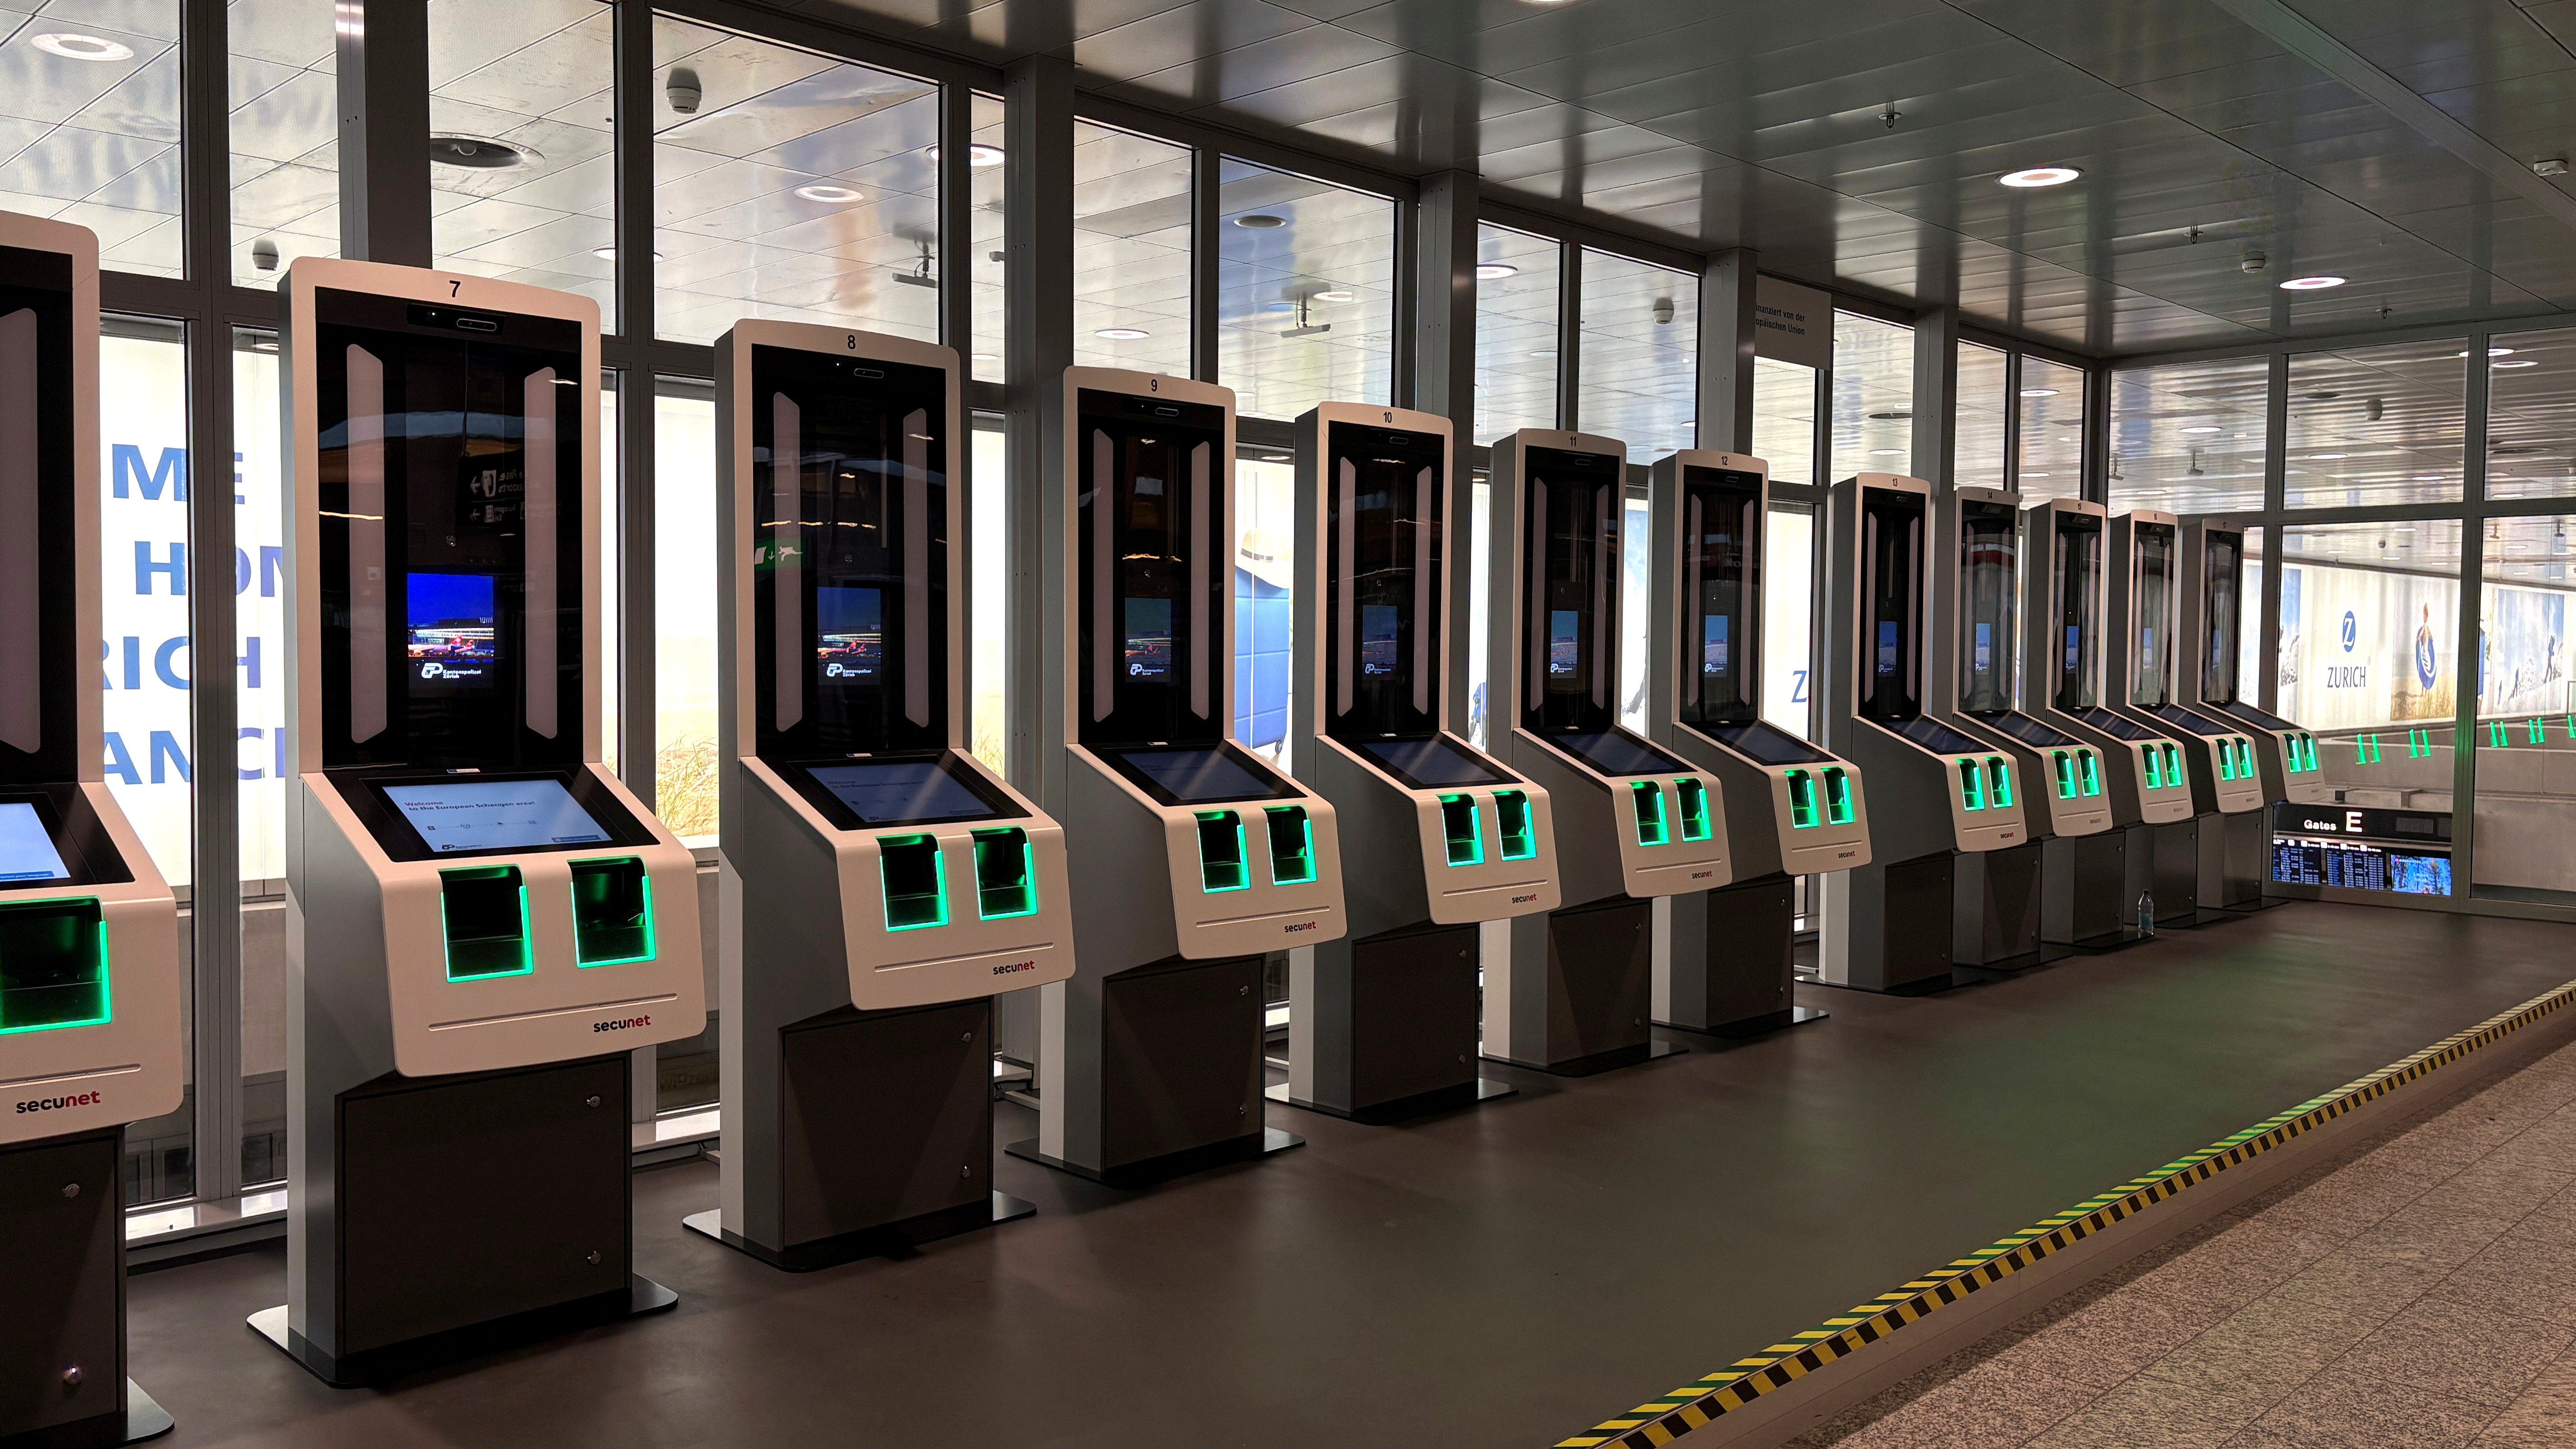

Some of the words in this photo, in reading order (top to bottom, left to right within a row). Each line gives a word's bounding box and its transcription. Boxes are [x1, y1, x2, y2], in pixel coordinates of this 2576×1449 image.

[449, 280, 461, 298] 7
[1783, 311, 1794, 320] von
[1795, 313, 1805, 322] der
[1788, 323, 1805, 335] Union
[847, 335, 856, 350] 8
[1151, 379, 1158, 392] 9
[1383, 411, 1392, 423] 10
[1569, 436, 1577, 447] 11
[1721, 455, 1728, 465] 12
[1892, 478, 1898, 487] 13
[2327, 666, 2366, 688] ZURICH
[2304, 819, 2337, 831] Gates
[2345, 811, 2363, 833] E
[1838, 851, 1855, 859] secunet
[1692, 870, 1713, 879] secunet
[1512, 893, 1537, 904] secunet
[1284, 921, 1316, 933] secunet
[993, 960, 1035, 975] secunet
[593, 1015, 651, 1033] secunet
[16, 1090, 101, 1114] secunet
